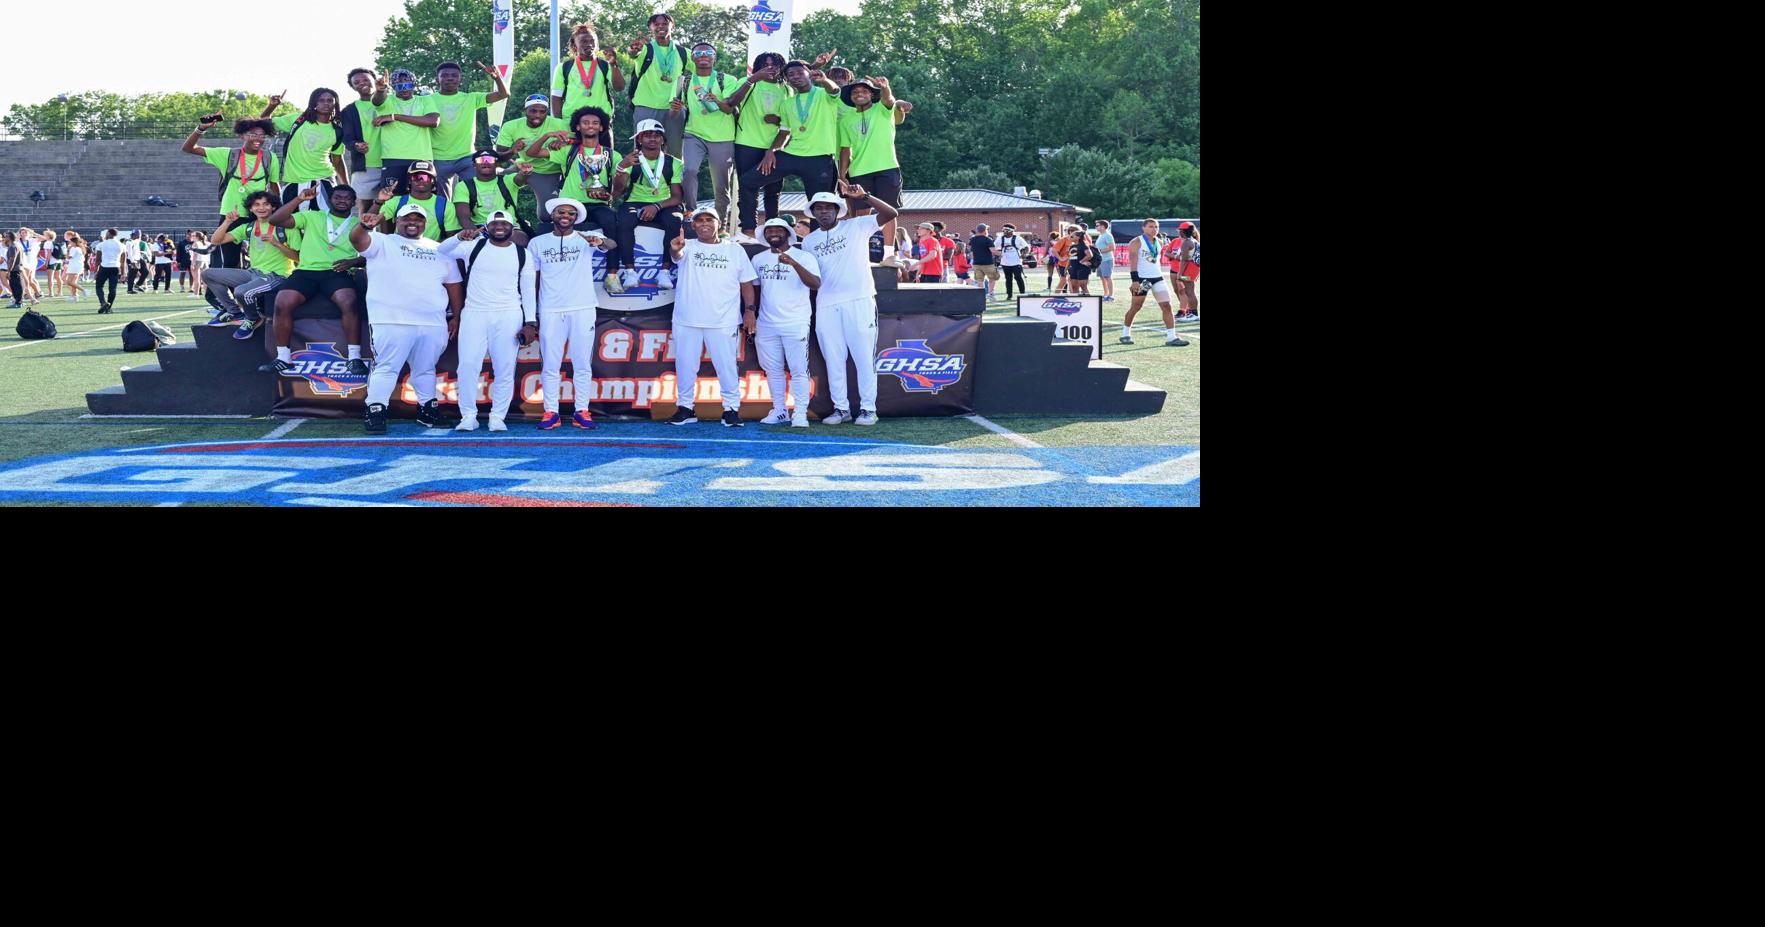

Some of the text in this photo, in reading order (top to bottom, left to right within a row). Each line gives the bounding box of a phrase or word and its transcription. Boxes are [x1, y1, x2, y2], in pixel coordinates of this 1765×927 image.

[750, 11, 784, 21] GHSA
[1060, 325, 1092, 340] 100
[599, 329, 634, 362] &
[282, 360, 370, 375] GHS
[875, 358, 962, 372] GHSA
